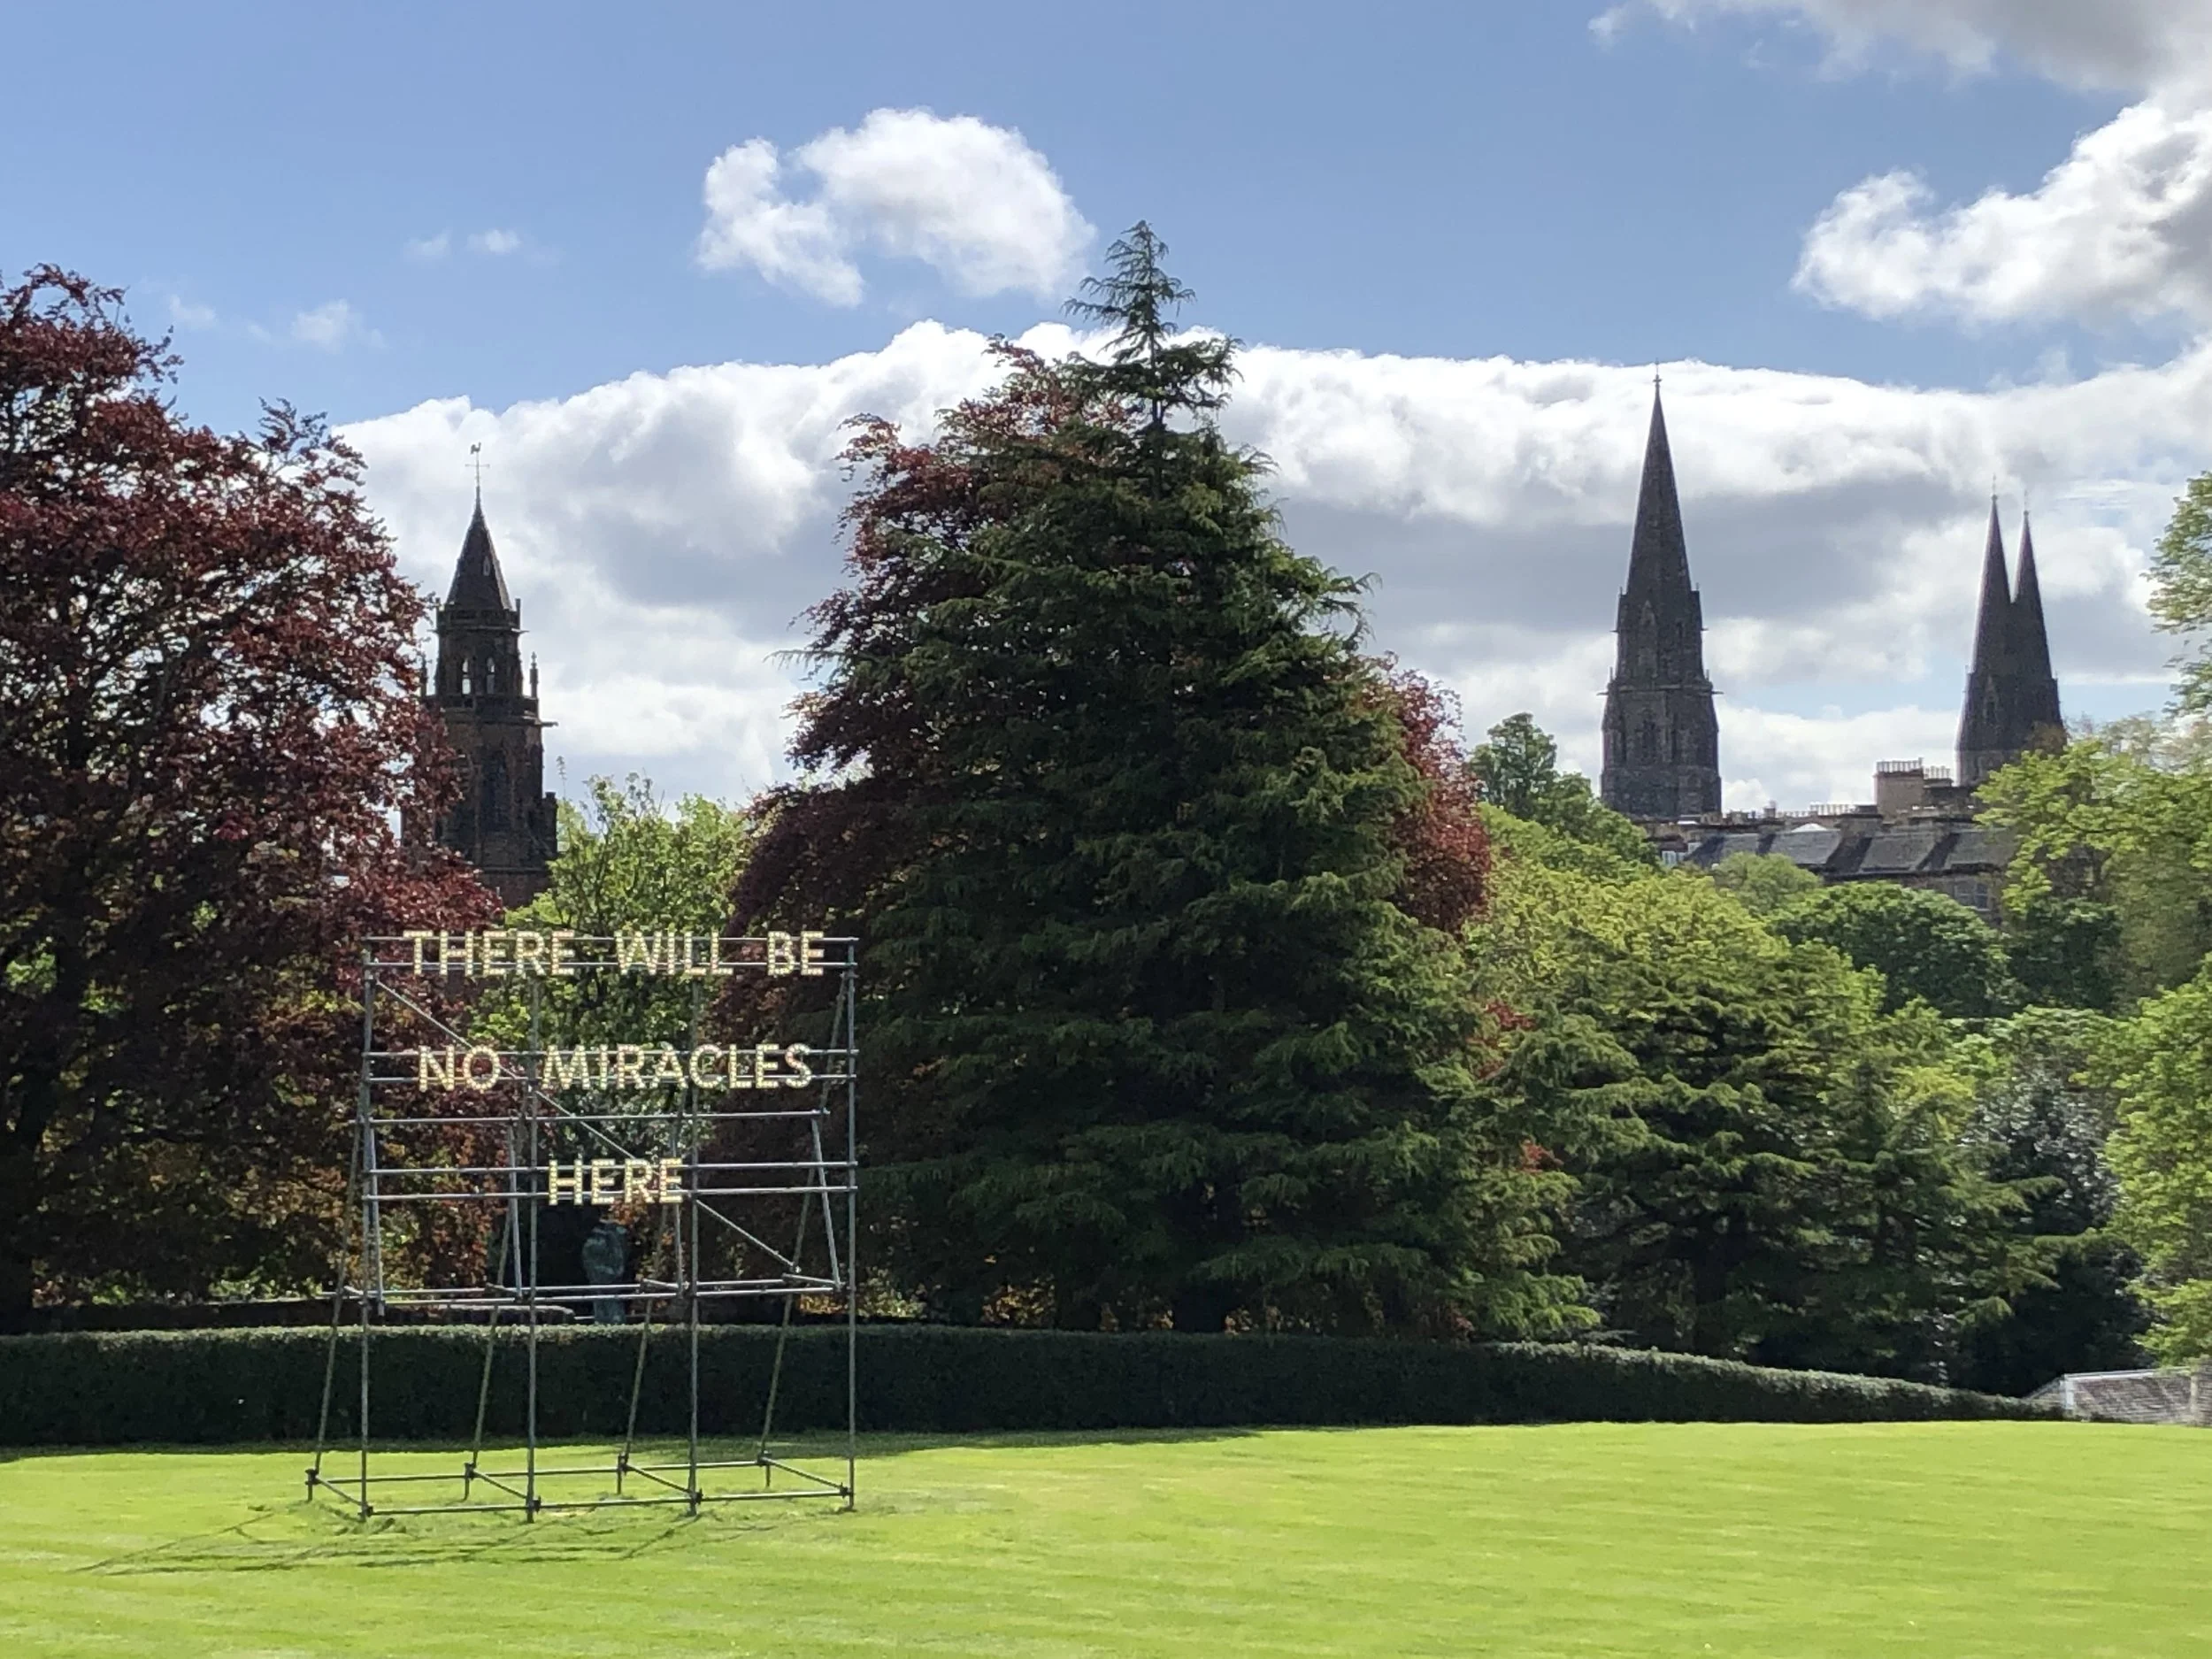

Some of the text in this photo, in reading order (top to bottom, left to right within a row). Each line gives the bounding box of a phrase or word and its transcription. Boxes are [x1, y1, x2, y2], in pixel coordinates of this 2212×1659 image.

[403, 930, 825, 976] THERE WILL BE
[418, 1043, 812, 1093] NO MIRACLES
[548, 1158, 684, 1206] HERE
